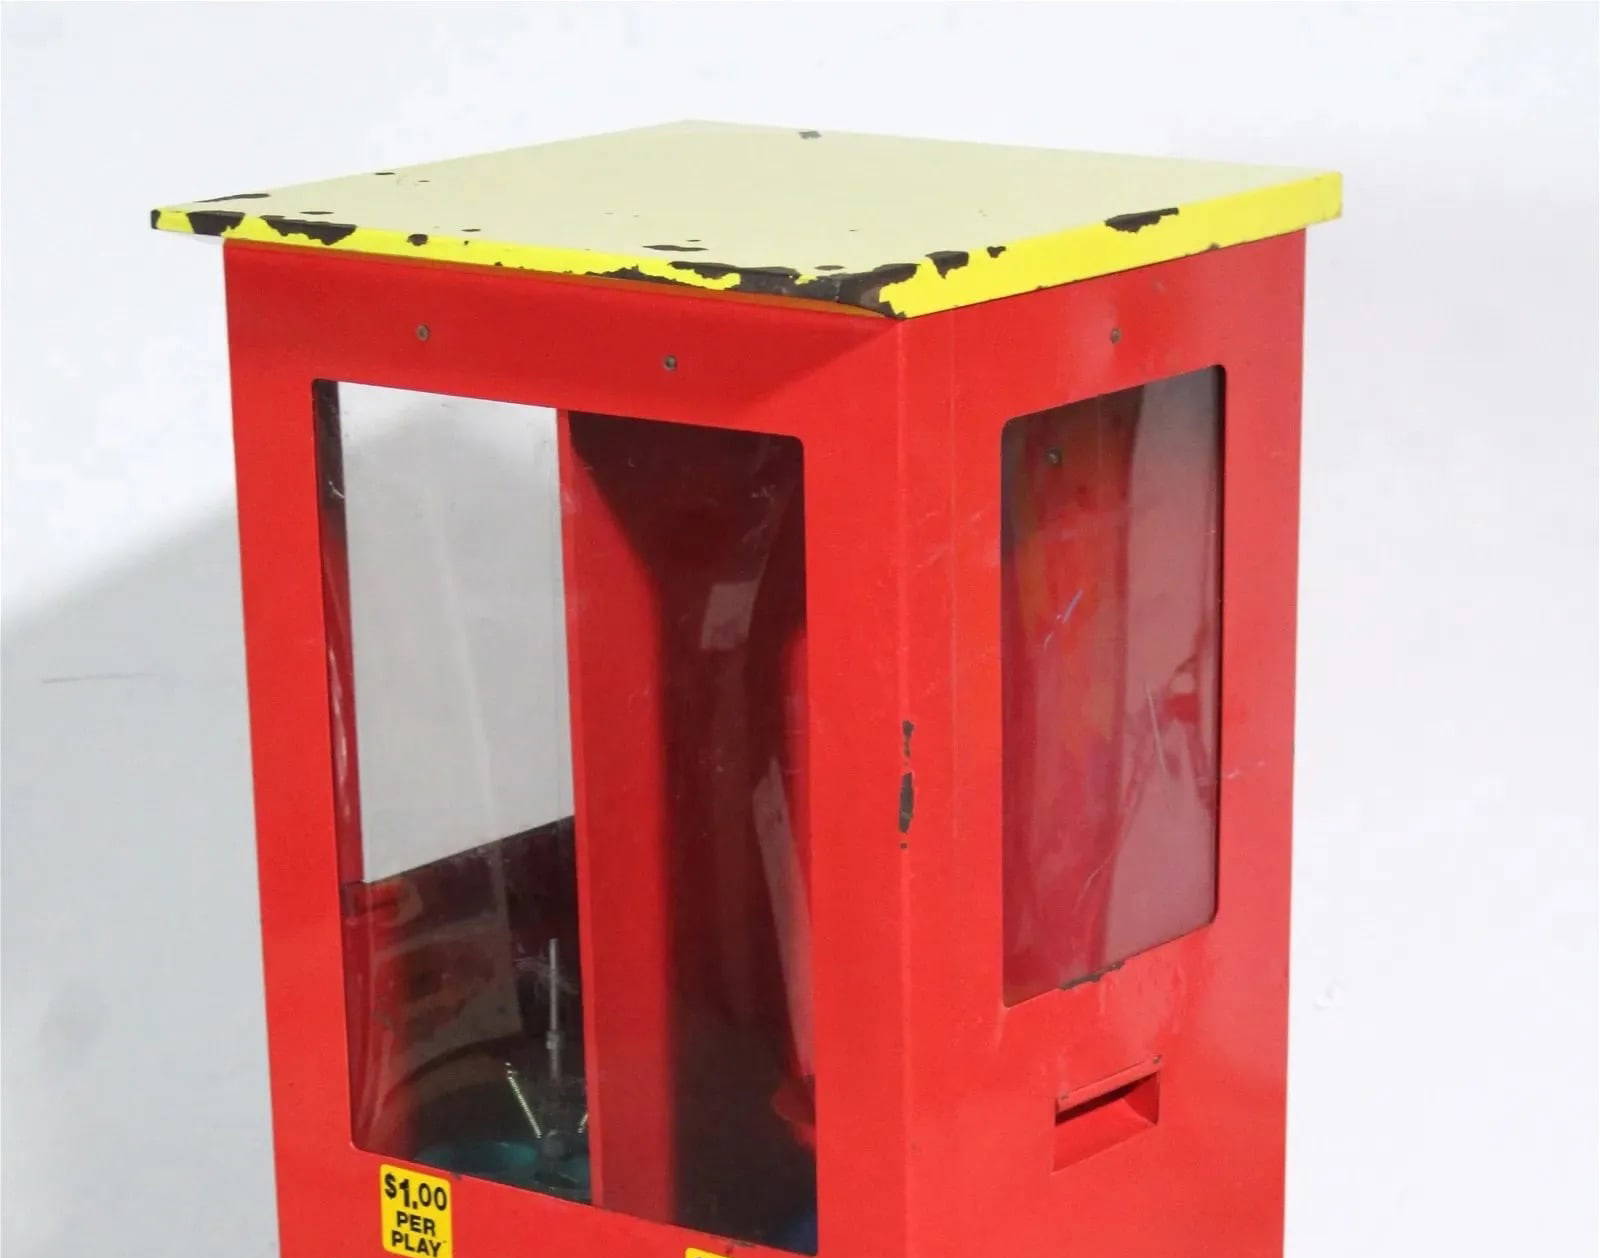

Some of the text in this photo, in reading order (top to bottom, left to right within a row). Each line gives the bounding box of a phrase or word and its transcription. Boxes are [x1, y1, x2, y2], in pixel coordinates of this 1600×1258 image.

[384, 1173, 447, 1211] $1.00
[396, 1210, 436, 1237] PER
[391, 1230, 442, 1258] PLAY
